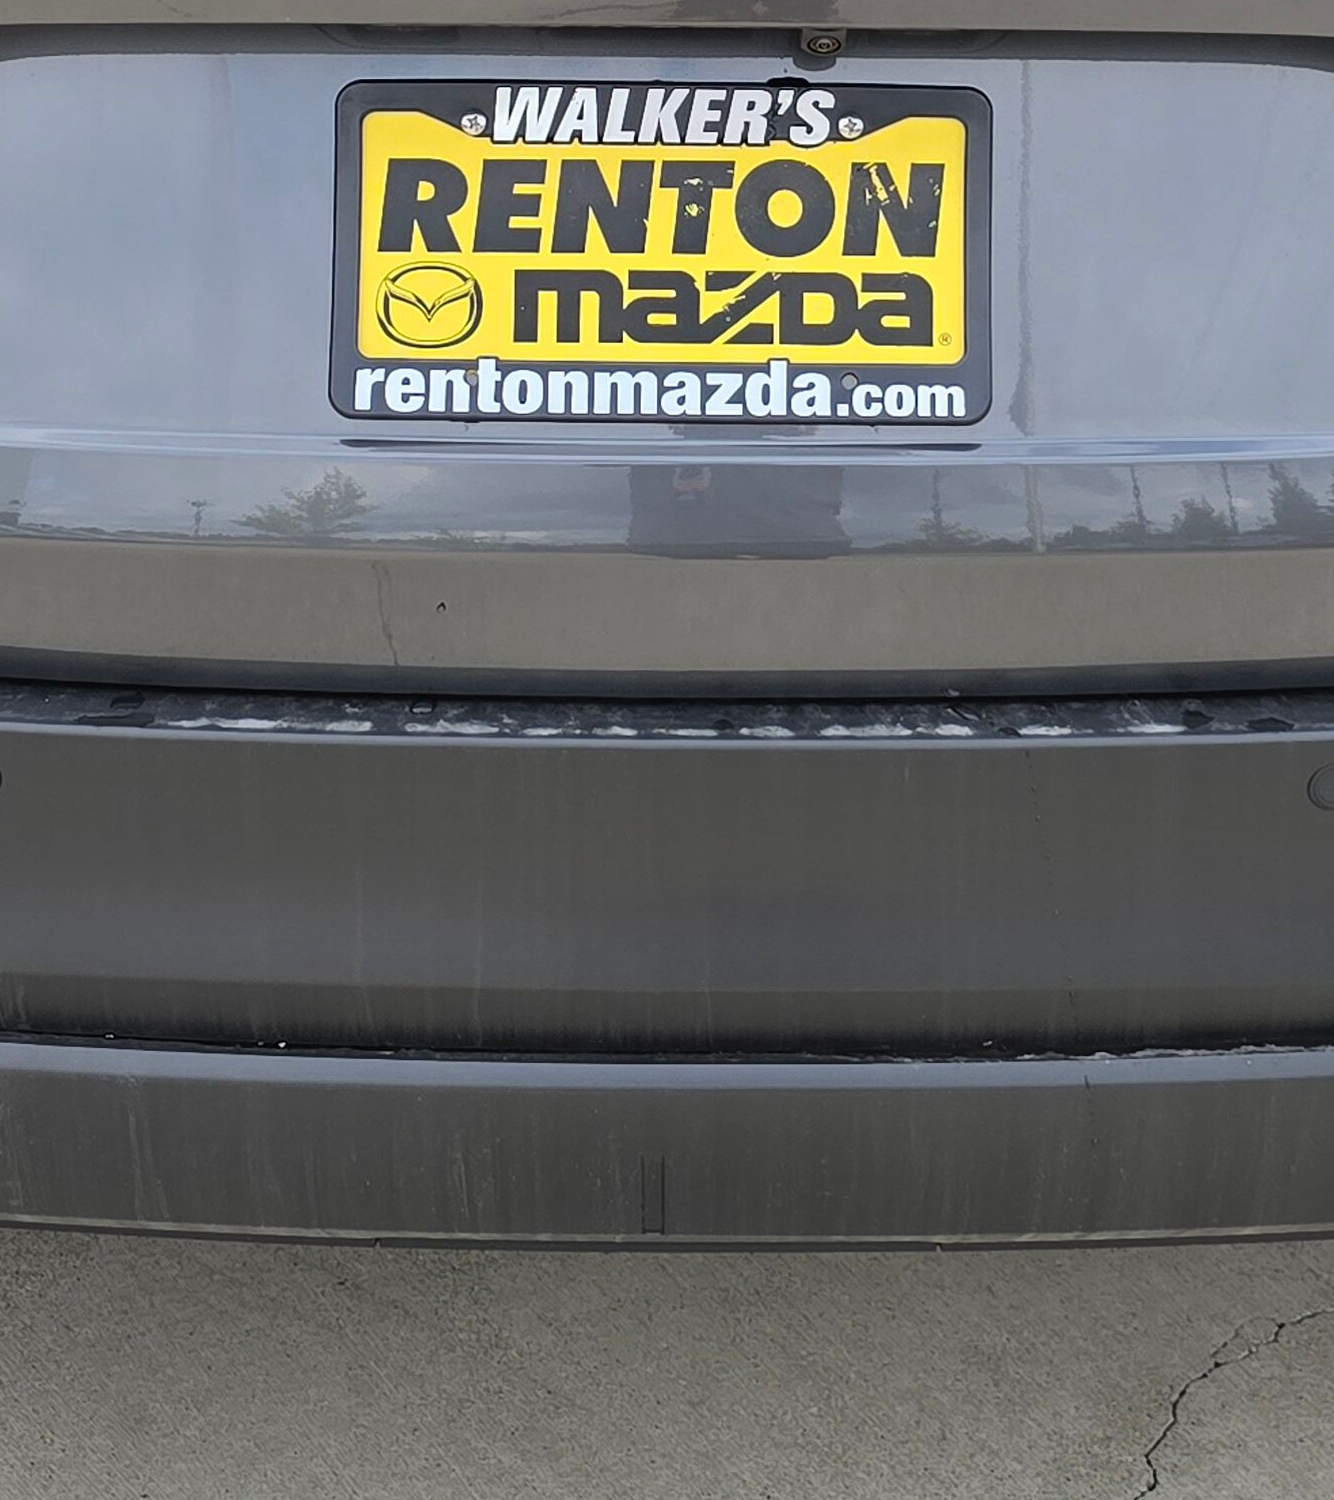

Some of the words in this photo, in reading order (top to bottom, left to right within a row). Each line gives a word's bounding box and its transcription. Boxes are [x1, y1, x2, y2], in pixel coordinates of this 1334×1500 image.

[490, 85, 837, 146] WALKER'S
[376, 158, 947, 259] RENTON
[353, 357, 967, 418] rentonmazda.com
